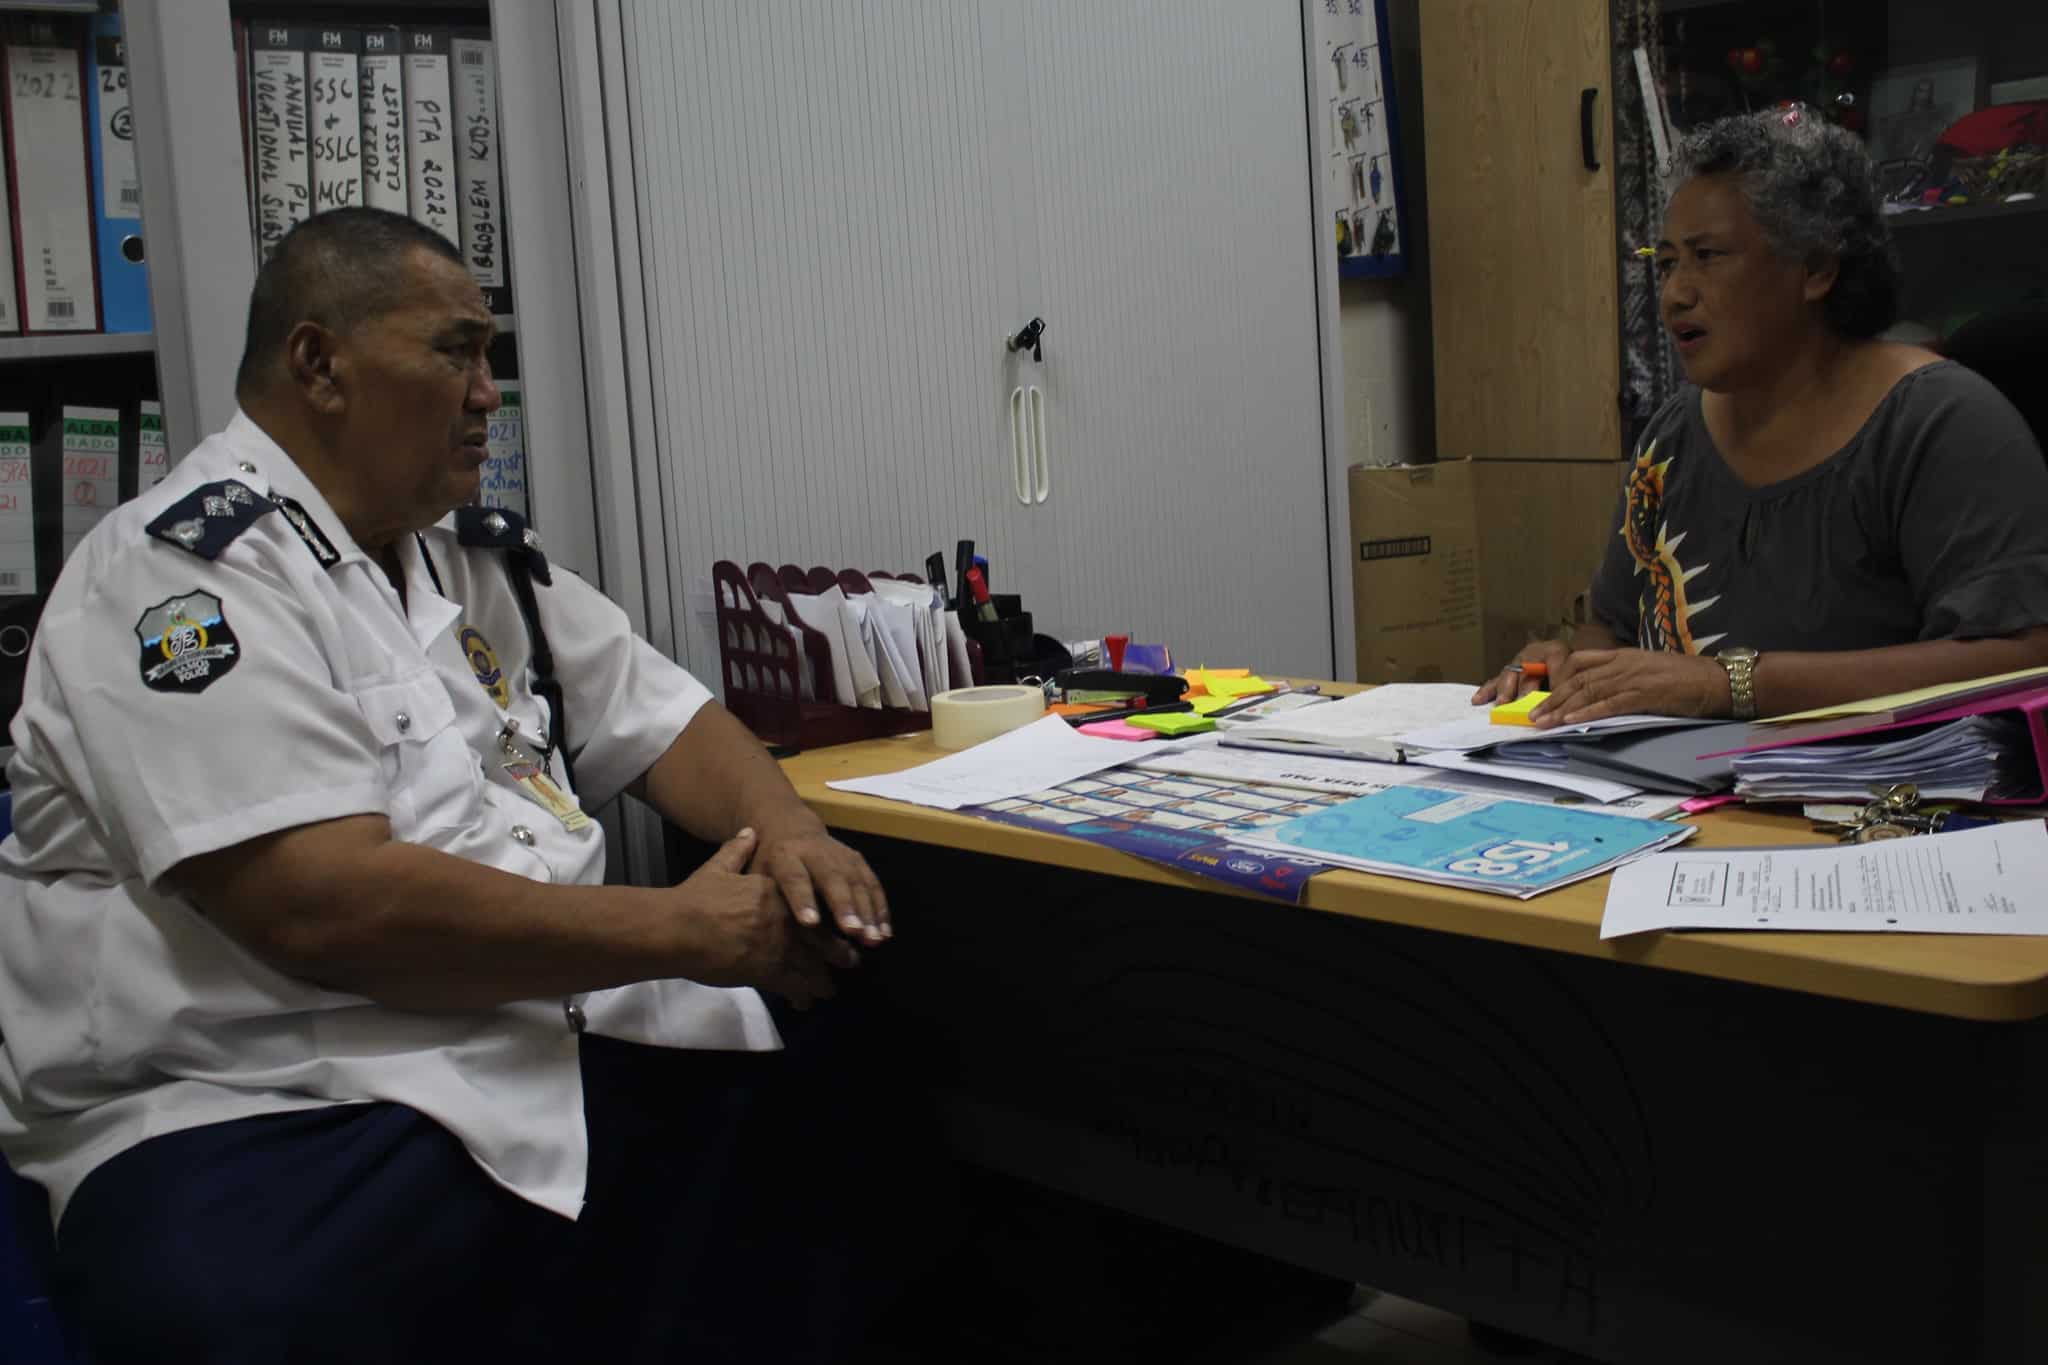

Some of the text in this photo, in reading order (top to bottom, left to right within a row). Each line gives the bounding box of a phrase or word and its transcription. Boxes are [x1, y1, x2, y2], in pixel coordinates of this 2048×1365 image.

[268, 29, 288, 44] FM
[322, 31, 341, 46] FM
[366, 34, 385, 48] FM
[414, 33, 432, 48] FM
[15, 71, 80, 101] 2022
[313, 77, 354, 104] SSC
[257, 69, 281, 183] VOCATIONAL
[284, 72, 305, 162] ANNUAL
[415, 100, 441, 144] PTA
[315, 135, 359, 164] SSLC
[318, 177, 358, 207] MCF
[66, 420, 117, 436] ALBA
[66, 437, 116, 449] RADO
